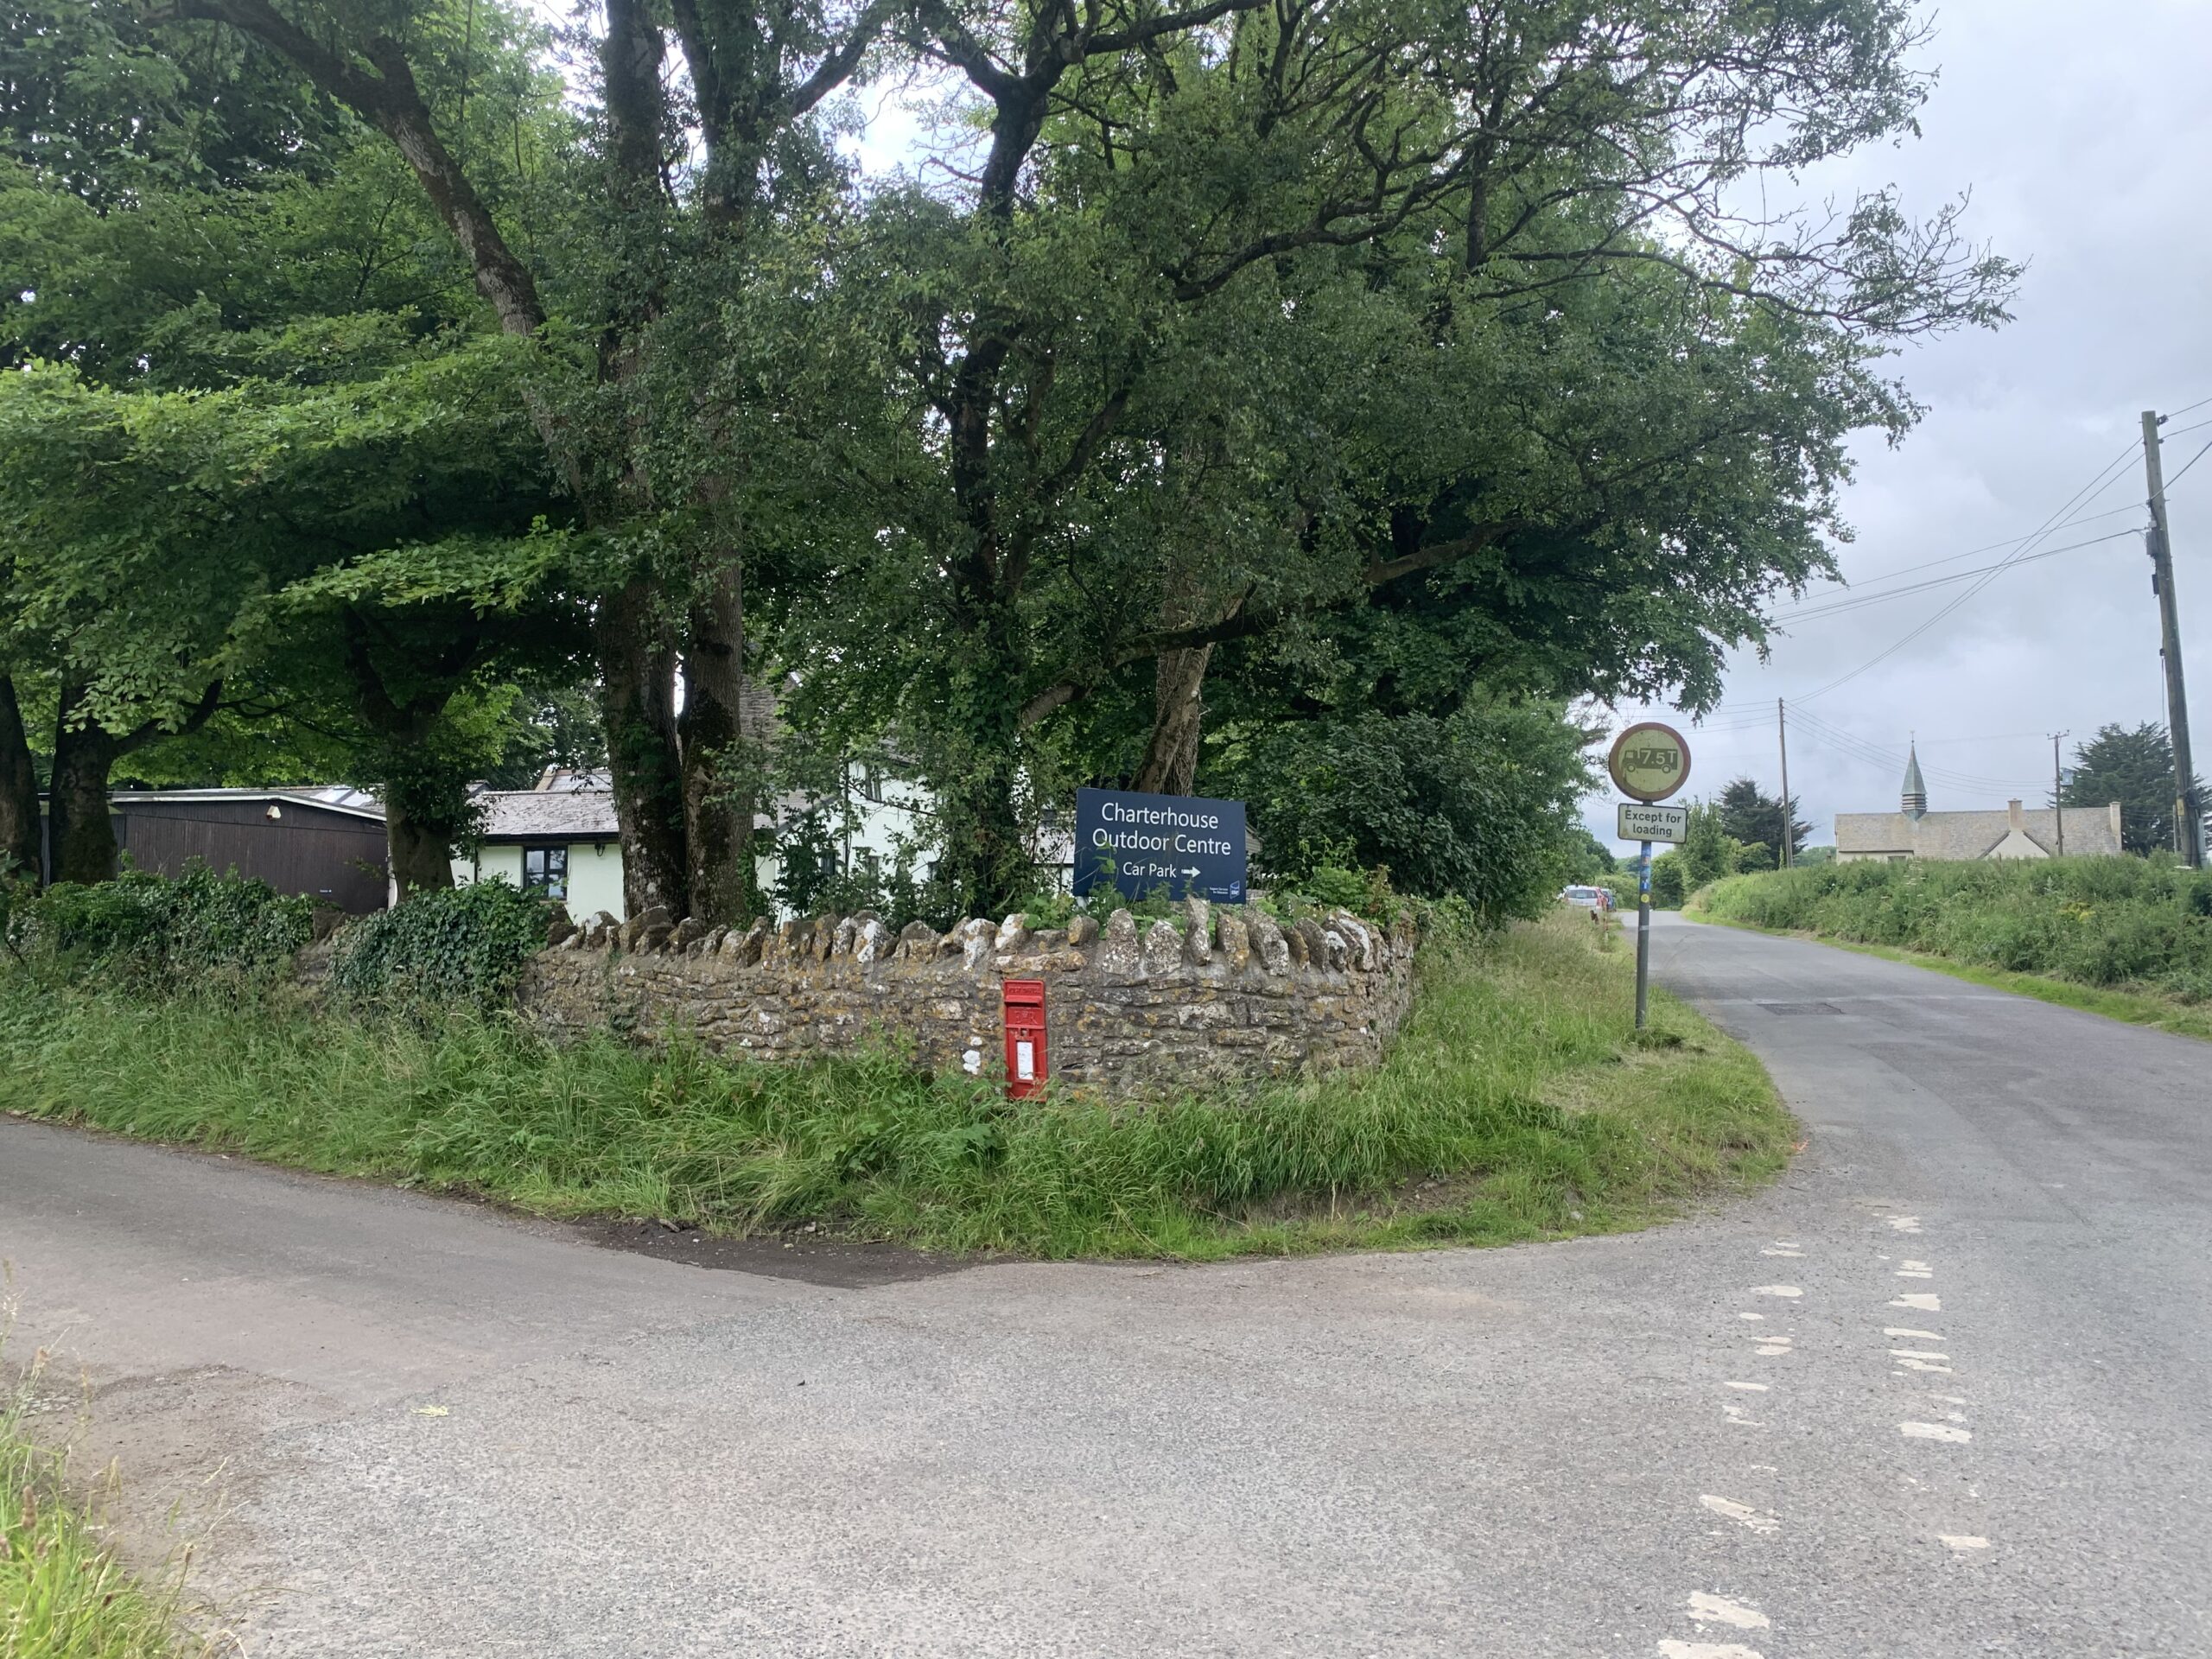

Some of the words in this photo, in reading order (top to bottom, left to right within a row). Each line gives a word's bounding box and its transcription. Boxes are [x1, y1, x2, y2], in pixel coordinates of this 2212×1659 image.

[1101, 802, 1219, 830] Charterhouse
[1624, 810, 1663, 823] Except
[1666, 812, 1682, 823] for
[1633, 823, 1673, 838] loading
[1092, 828, 1170, 851] Outdoor
[1174, 834, 1232, 855] Centre
[1122, 861, 1146, 876] Car
[1149, 863, 1177, 879] Park
